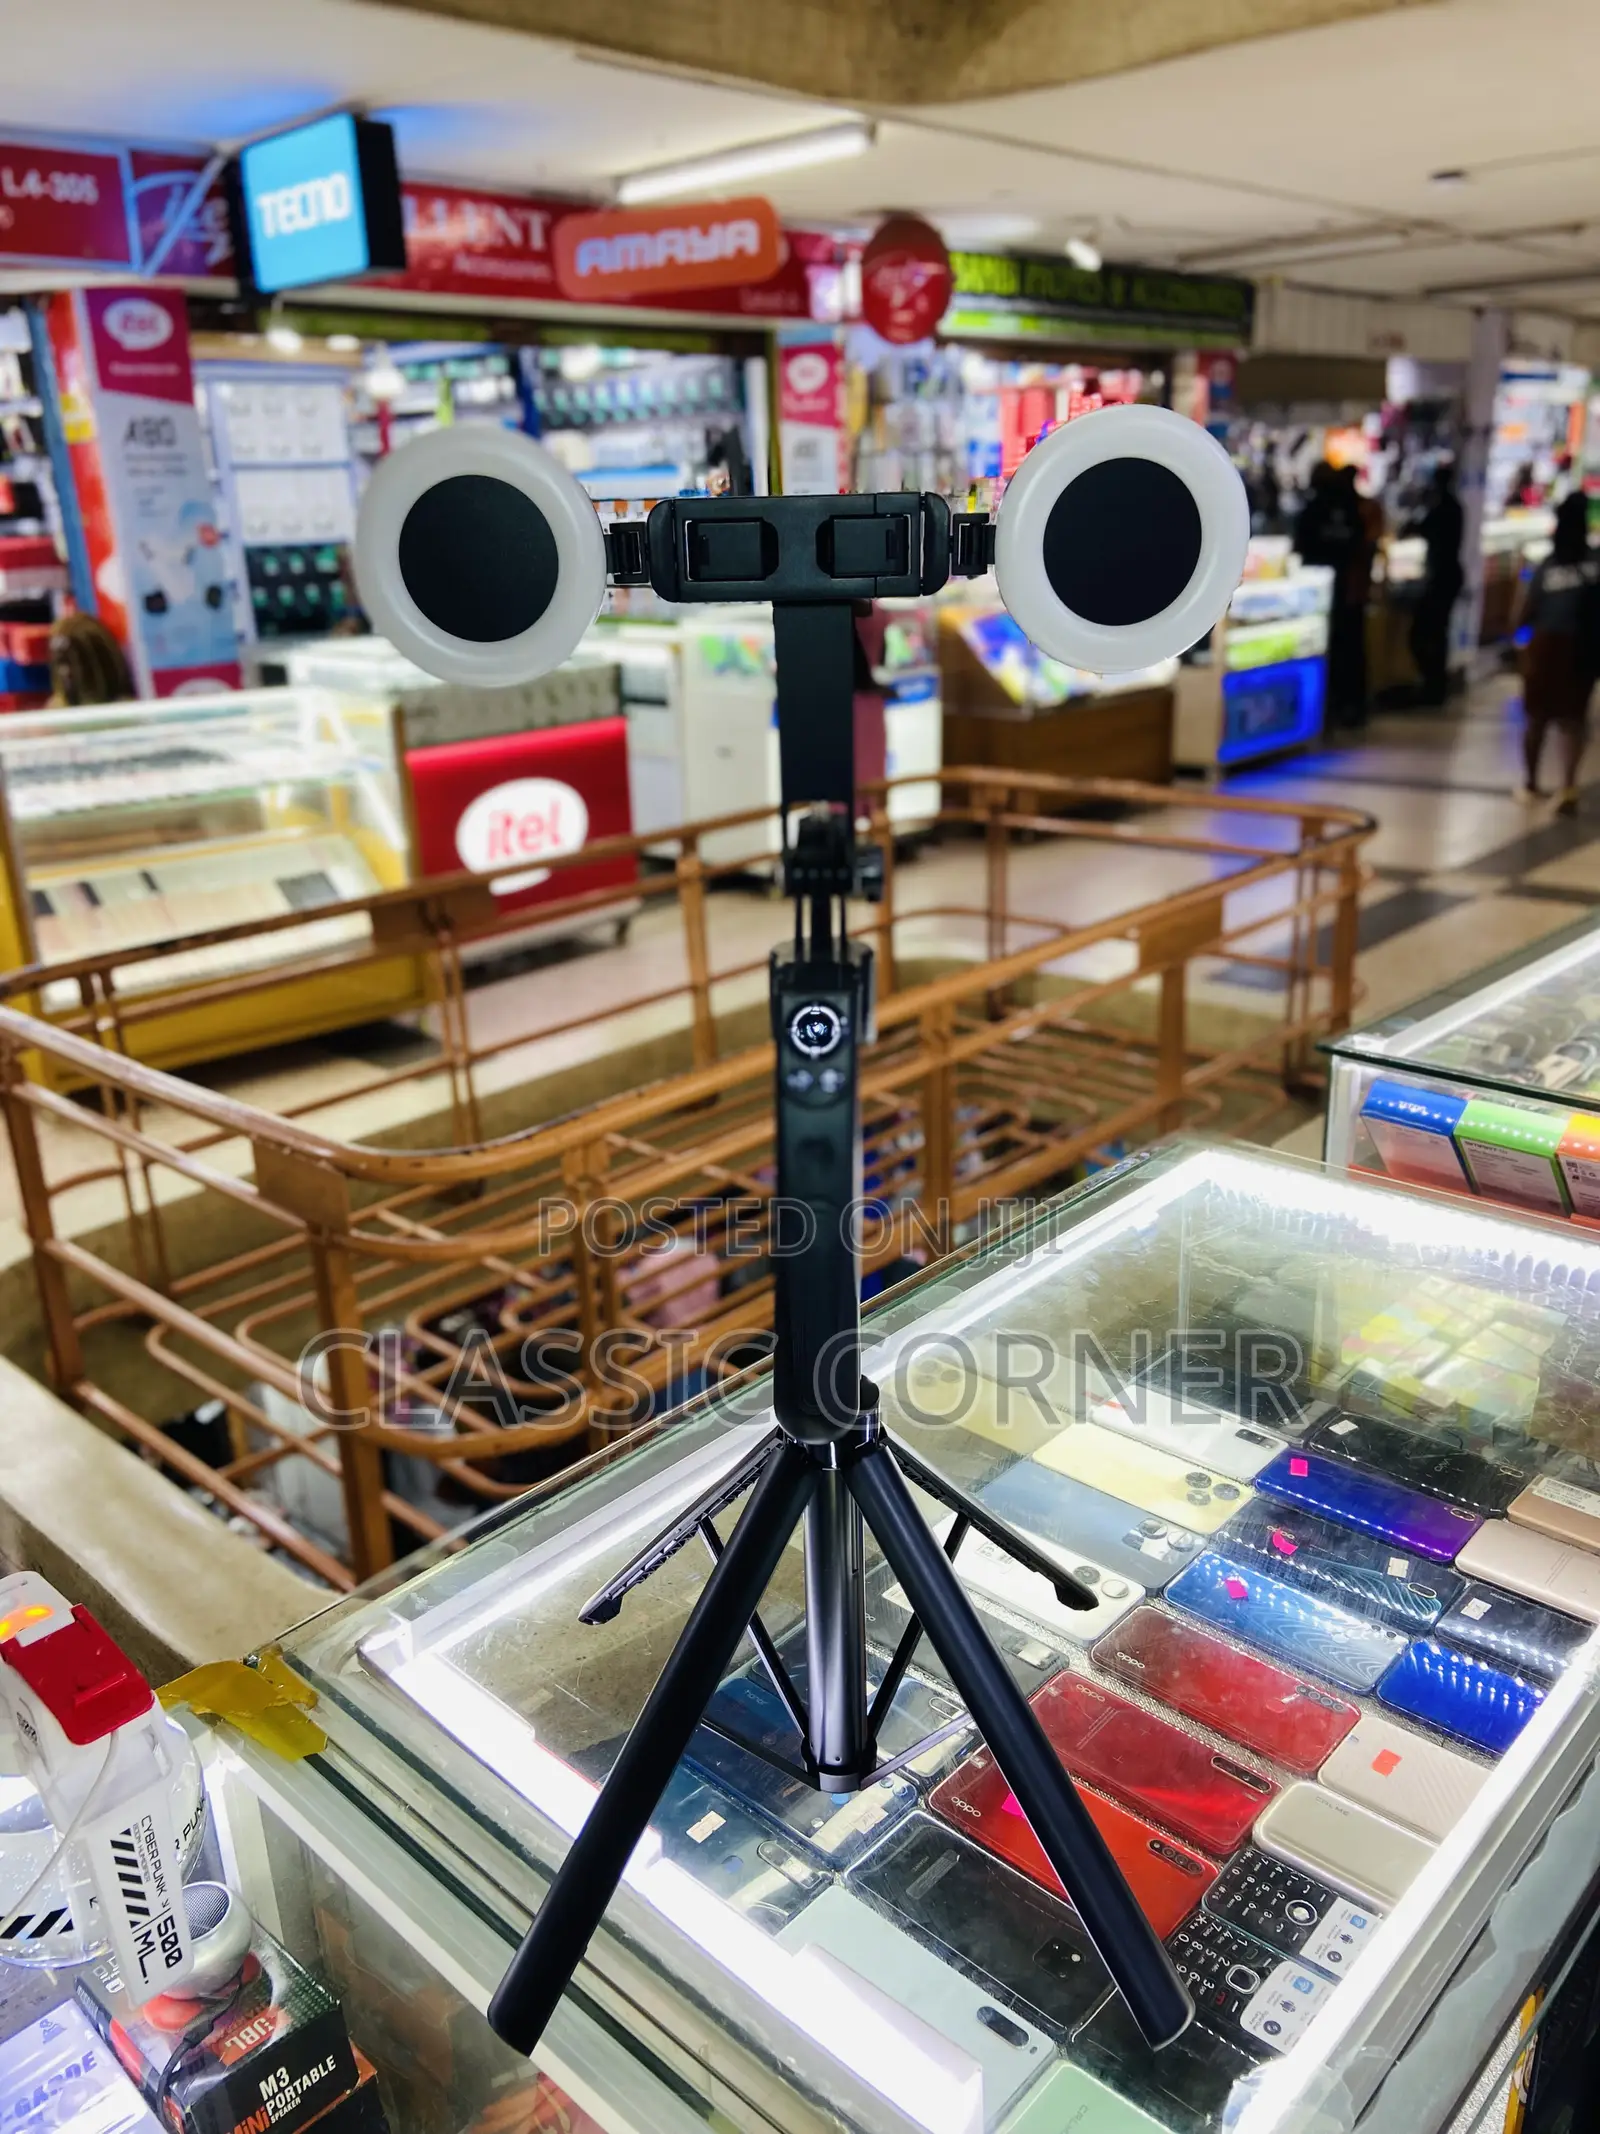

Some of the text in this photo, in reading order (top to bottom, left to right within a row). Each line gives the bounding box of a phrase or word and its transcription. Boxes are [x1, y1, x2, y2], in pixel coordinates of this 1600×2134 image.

[256, 173, 351, 238] TECNO
[576, 218, 760, 277] AMAYA
[487, 798, 562, 862] itel
[1117, 1651, 1145, 1669] oppo
[1076, 1683, 1105, 1702] oppo
[951, 1796, 981, 1818] oppo
[151, 1858, 167, 1897] PUNK
[1212, 1922, 1222, 1932] 7
[1223, 1930, 1234, 1940] 4
[157, 1914, 183, 1969] 500
[1178, 1933, 1190, 1943] 0
[1192, 1940, 1203, 1950] 8
[1237, 1938, 1248, 1948] 1
[1206, 1948, 1216, 1959] 5
[1218, 1956, 1230, 1967] 2
[1176, 1963, 1188, 1974] 9
[1190, 1971, 1200, 1982] 6
[1203, 1978, 1215, 1990] 3
[258, 2066, 291, 2101] M3
[265, 2055, 337, 2117] PORTABLE
[270, 2097, 301, 2124] SPEAKER
